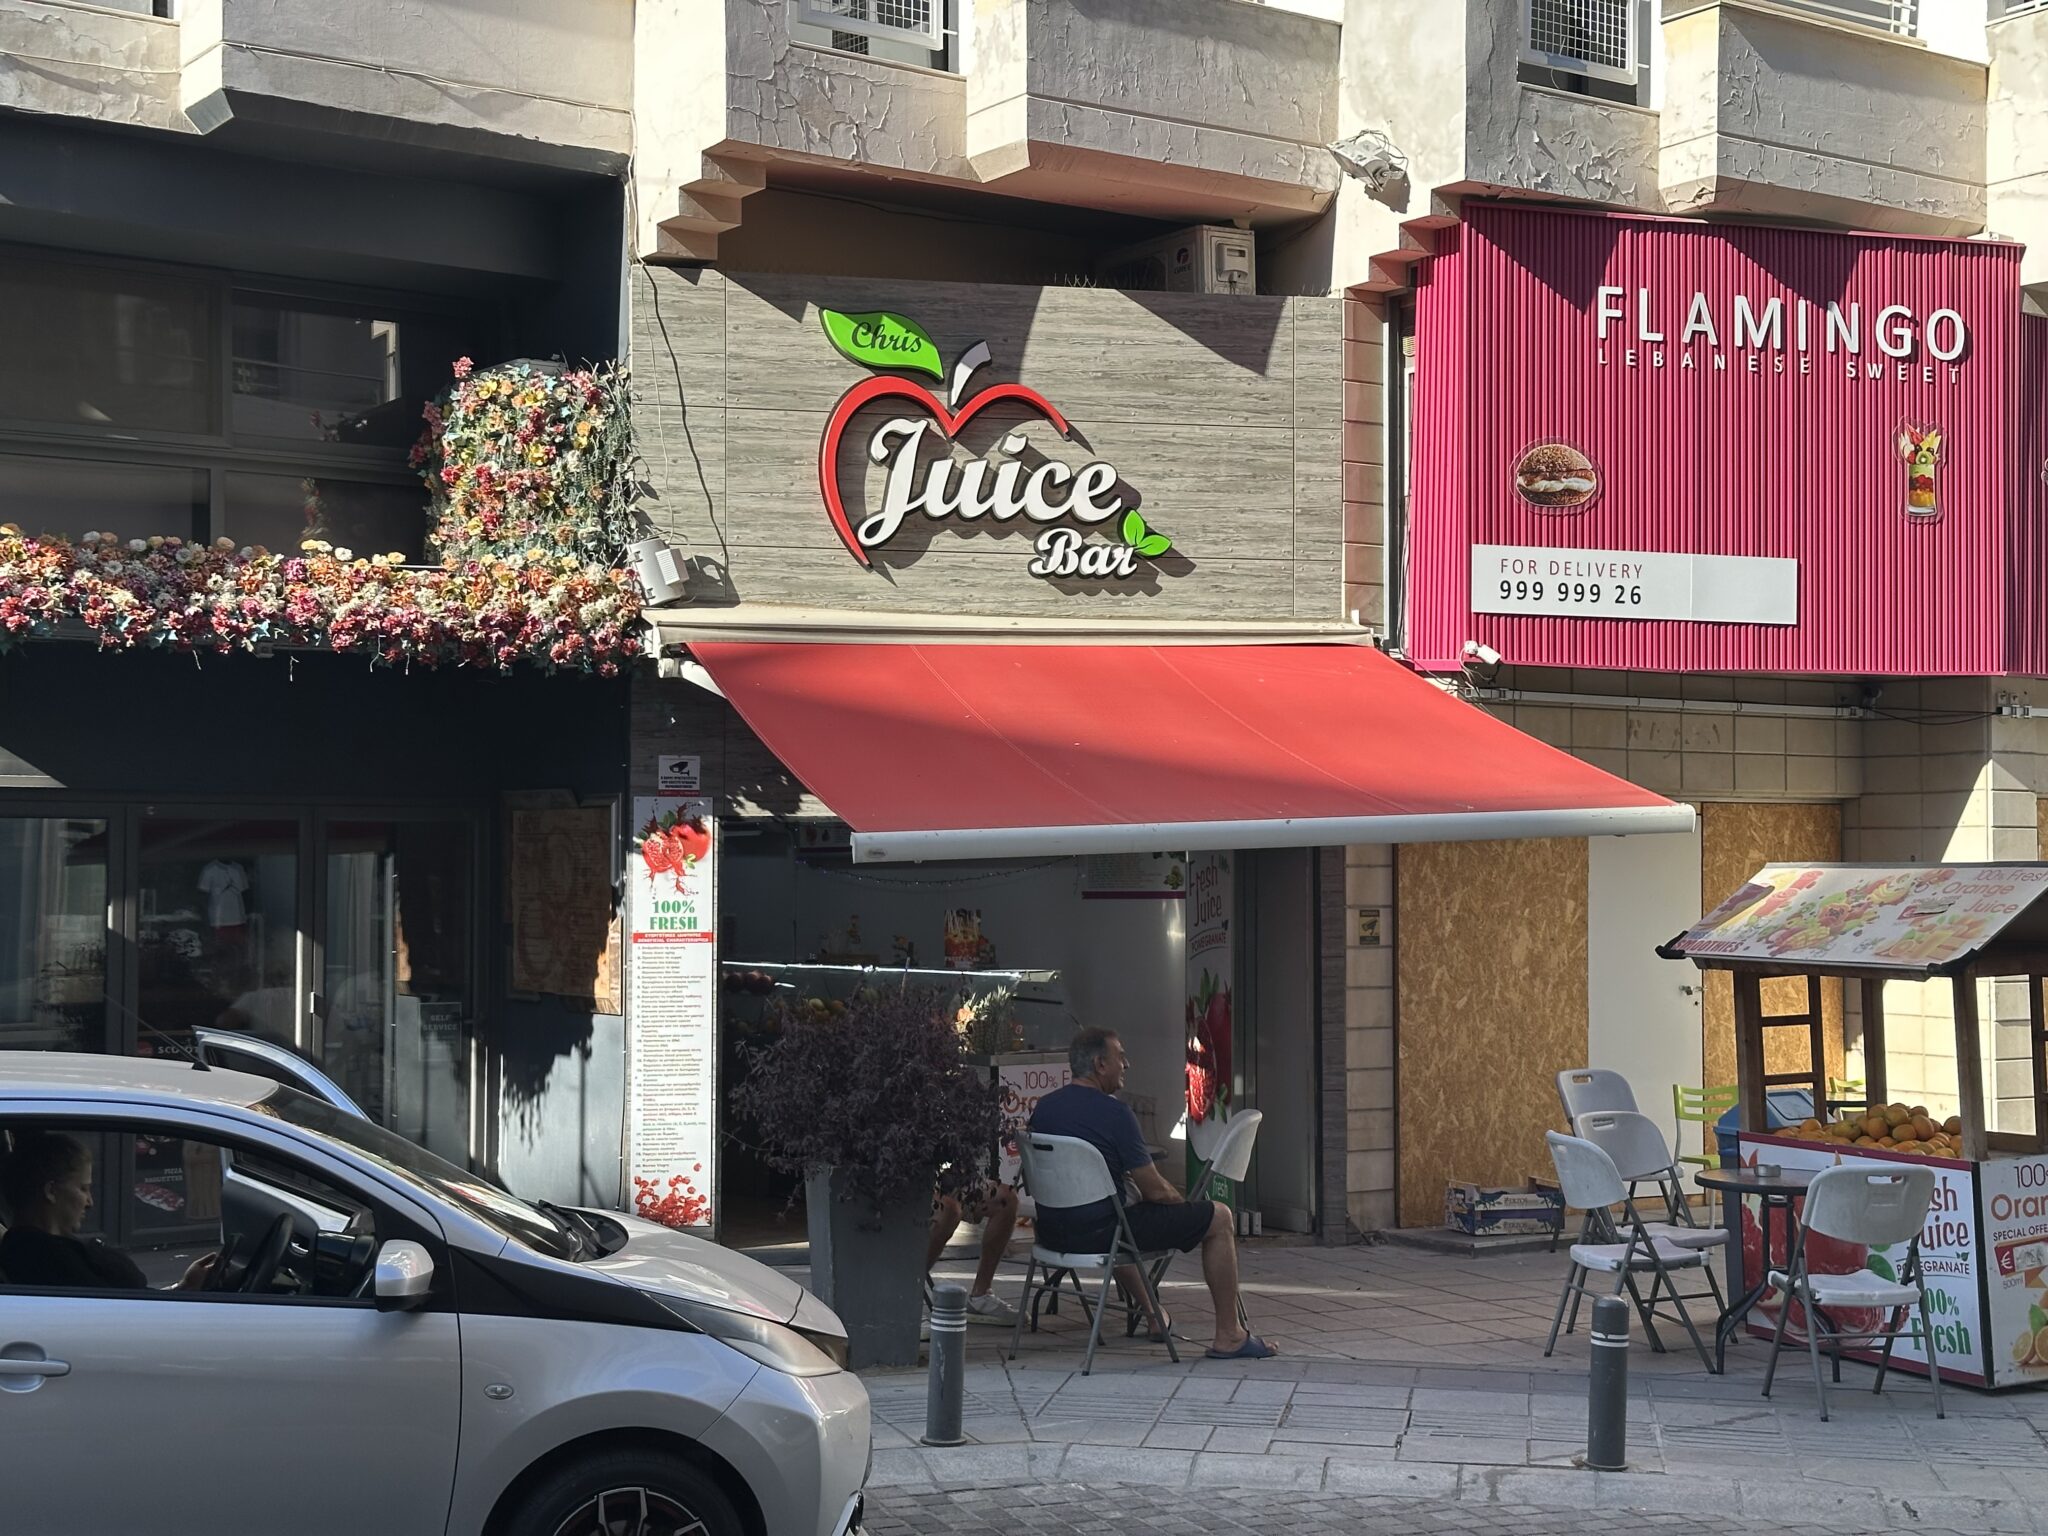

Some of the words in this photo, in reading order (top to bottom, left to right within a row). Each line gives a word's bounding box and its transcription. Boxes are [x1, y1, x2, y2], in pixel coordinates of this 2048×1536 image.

[1597, 285, 1965, 361] FLAMINGO
[851, 321, 922, 353] Chris
[1599, 348, 1810, 374] LEBANESE
[1846, 361, 1959, 384] SWEET
[857, 418, 1122, 547] Juice
[1030, 528, 1138, 577] Bar
[1500, 558, 1538, 575] FOR
[1549, 560, 1644, 579] DELIVERY
[1499, 580, 1544, 601] 999
[1557, 583, 1602, 603] 999
[1614, 585, 1642, 605] 26
[1942, 881, 2015, 898] Orange
[652, 900, 695, 914] 100%
[1963, 899, 2019, 914] Juice
[649, 916, 698, 930] FRESH
[1024, 1070, 1058, 1089] 100%
[2013, 1163, 2048, 1189] 100
[1920, 1215, 1970, 1251] uice
[1993, 1228, 2026, 1241] SPECIAL
[1896, 1261, 1970, 1275] PEGRANATE
[1919, 1288, 1960, 1316] 00%
[1910, 1317, 1973, 1356] Fesh
